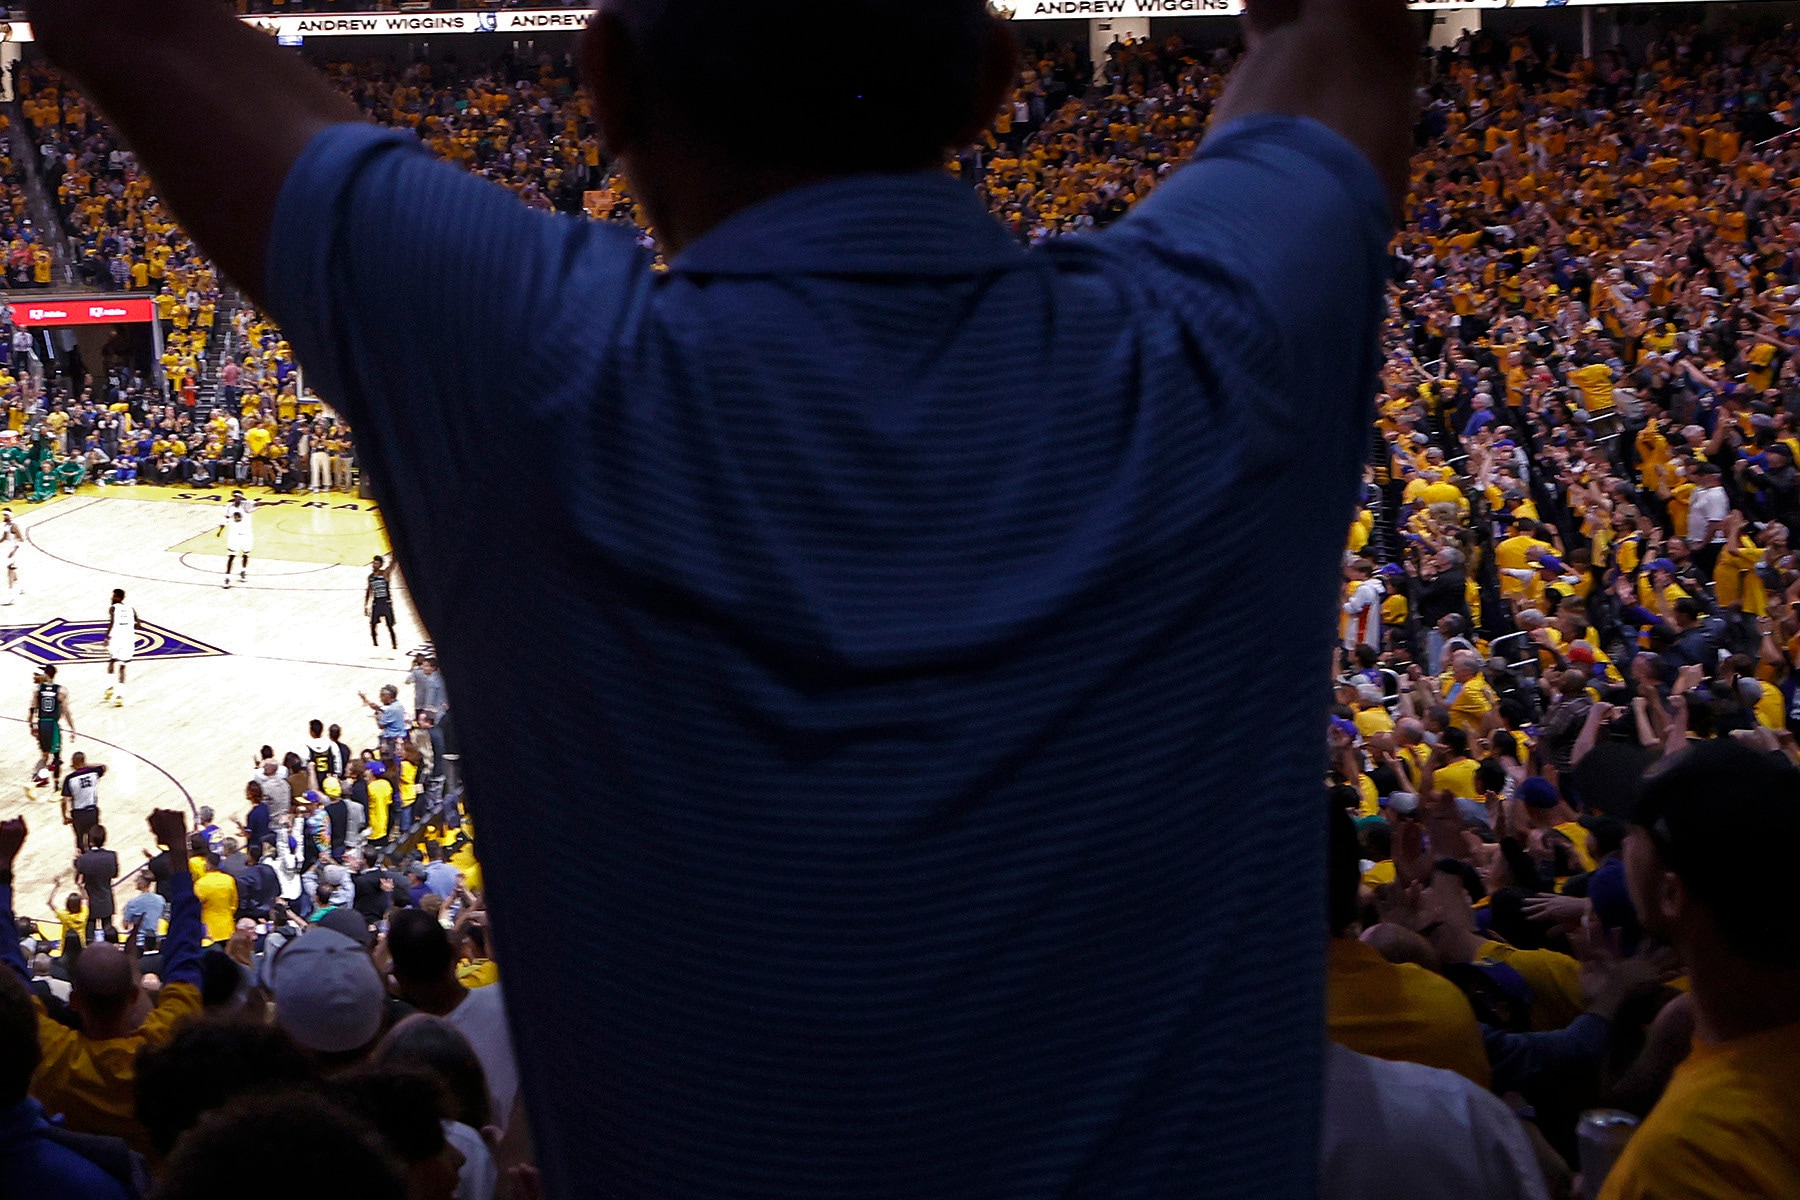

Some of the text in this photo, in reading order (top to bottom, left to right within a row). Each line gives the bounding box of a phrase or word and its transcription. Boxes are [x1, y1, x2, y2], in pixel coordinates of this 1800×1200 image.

[1034, 0, 1126, 15] ANDREW
[297, 16, 465, 32] ANDREW WIGGINS
